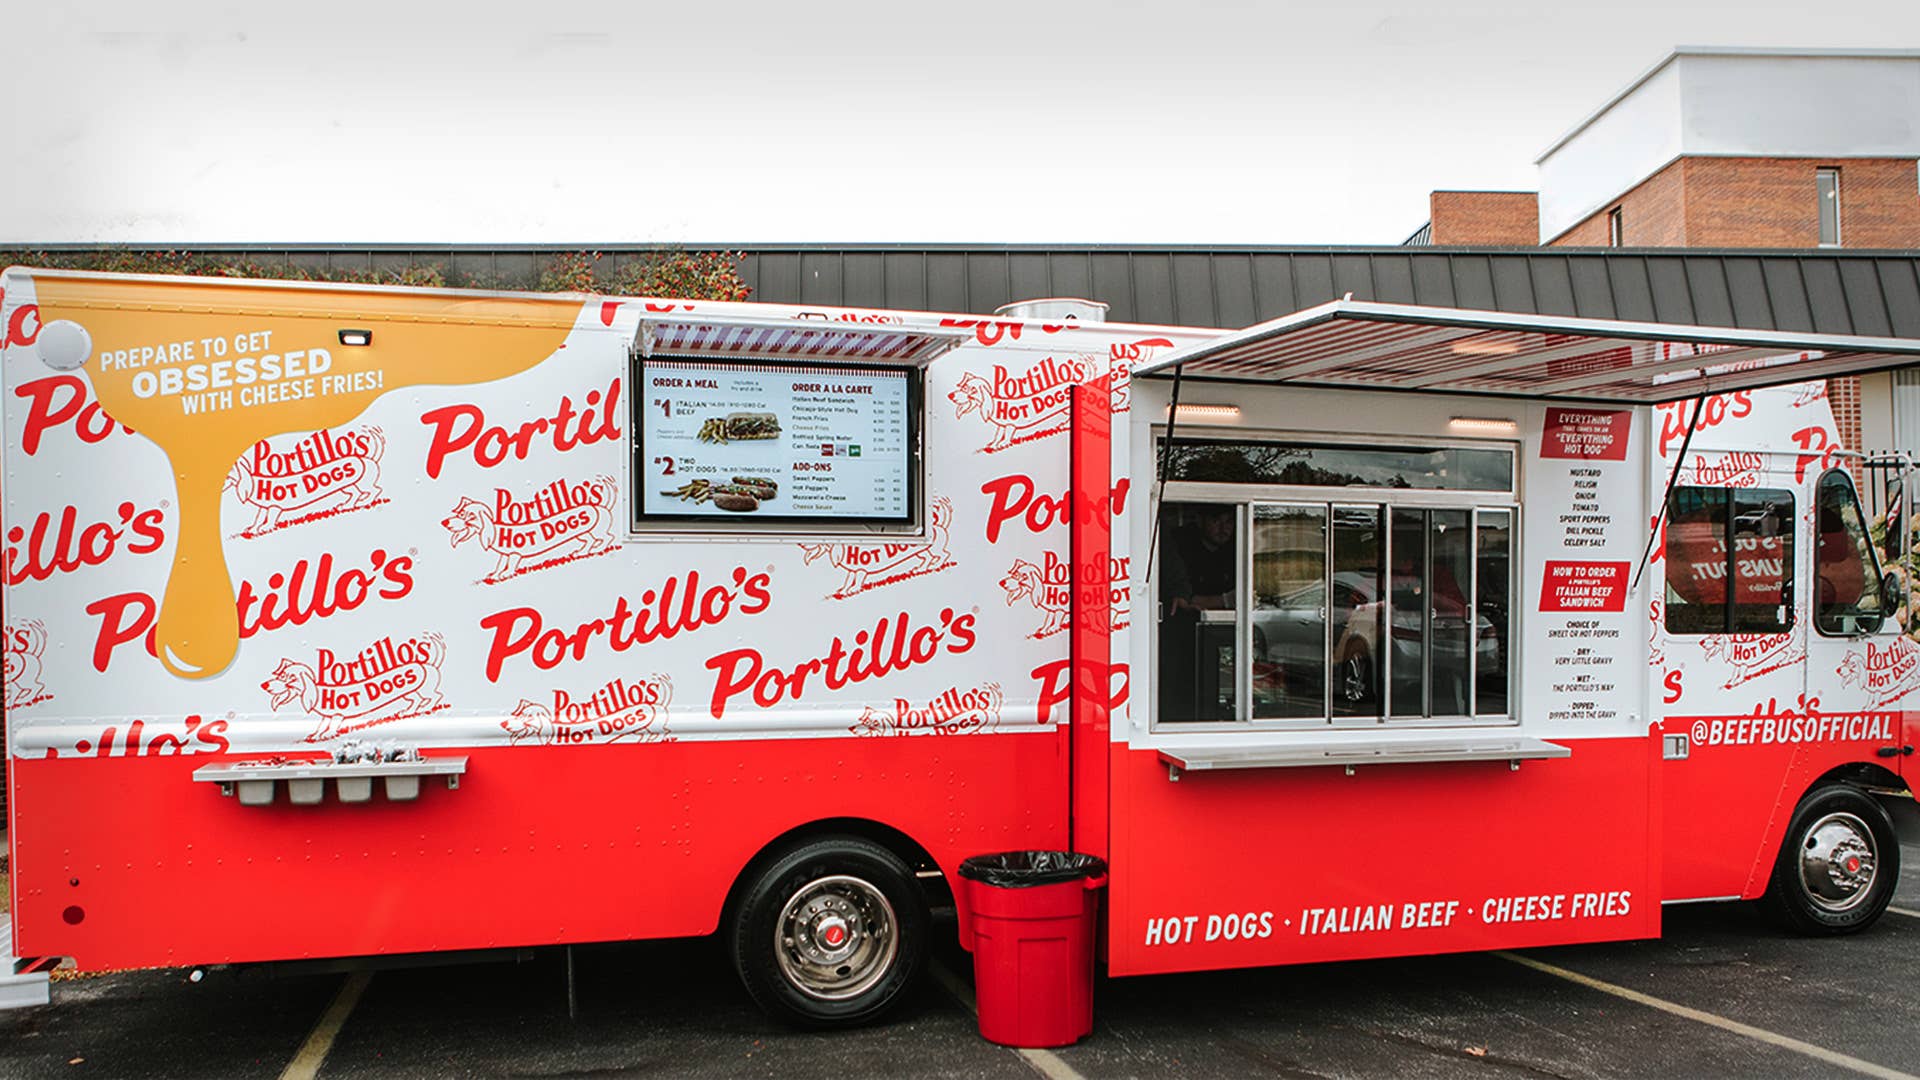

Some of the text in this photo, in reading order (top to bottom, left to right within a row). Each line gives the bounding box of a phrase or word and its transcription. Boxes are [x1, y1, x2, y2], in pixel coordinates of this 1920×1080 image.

[100, 330, 273, 373] PREPARE TO GET
[131, 347, 332, 399] OBSESSED
[992, 356, 1085, 399] Portillo's
[652, 377, 719, 389] ORDER A MEAL
[791, 382, 873, 394] ORDER A LA CARTE
[181, 370, 384, 416] WITH CHEESE FRIES!
[653, 398, 671, 417] #1
[675, 400, 707, 409] ITALIAN
[996, 387, 1071, 421] HOT DOGS
[676, 408, 695, 416] BEEF
[1558, 413, 1613, 426] EVERYTHING
[1556, 432, 1614, 445] "EVERYTHING
[253, 428, 372, 477] Portillo's
[1563, 444, 1581, 454] HOT
[654, 456, 676, 475] #2
[679, 457, 696, 465] TWO
[792, 462, 832, 472] ADD-ONS
[678, 465, 694, 473] HOT
[1569, 468, 1602, 477] MUSTARD
[256, 461, 356, 502] HOT DOGS
[1574, 480, 1597, 489] RELISH
[494, 478, 605, 525] Portillo's
[1574, 492, 1596, 500] ONION
[1572, 503, 1599, 512] TOMATO
[1559, 515, 1611, 524] SPORT PEPPERS
[498, 508, 590, 549] HOT DOGS
[1566, 526, 1604, 535] DILL PICKLE
[1564, 538, 1606, 547] CELERY SALT
[846, 545, 881, 566] HOT
[1552, 566, 1617, 577] HOW TO ORDER
[1555, 586, 1614, 597] ITALIAN BEEF
[1559, 597, 1605, 608] SANDWICH
[480, 568, 771, 683] Portillo's
[1566, 620, 1600, 629] CHOICE OF
[1548, 629, 1620, 638] SWEET OR HOT PEPPERS
[1576, 648, 1591, 656] DRY
[1733, 644, 1757, 661] HOT
[1760, 632, 1791, 651] DOGS
[316, 636, 431, 686] Portillo's
[704, 608, 977, 719] Portillo's
[1555, 657, 1613, 665] VERY LITTLE GRAVY
[1576, 675, 1591, 683] WET
[1868, 672, 1890, 688] HOT
[320, 671, 418, 711] HOT DOGS
[1552, 684, 1565, 692] THE
[1565, 684, 1600, 692] PORTILLO'S
[551, 677, 660, 723] Portillo's
[1571, 702, 1595, 710] DIPPED
[893, 686, 990, 729] Portillo's
[1548, 711, 1570, 720] DIPPED
[556, 708, 647, 744] HOT DOGS
[1691, 715, 1893, 747] @BEEFBUSOFFICIAL
[1144, 890, 1632, 946] HOT DOGS ITALIAN BEEF CHEESE FRIES
